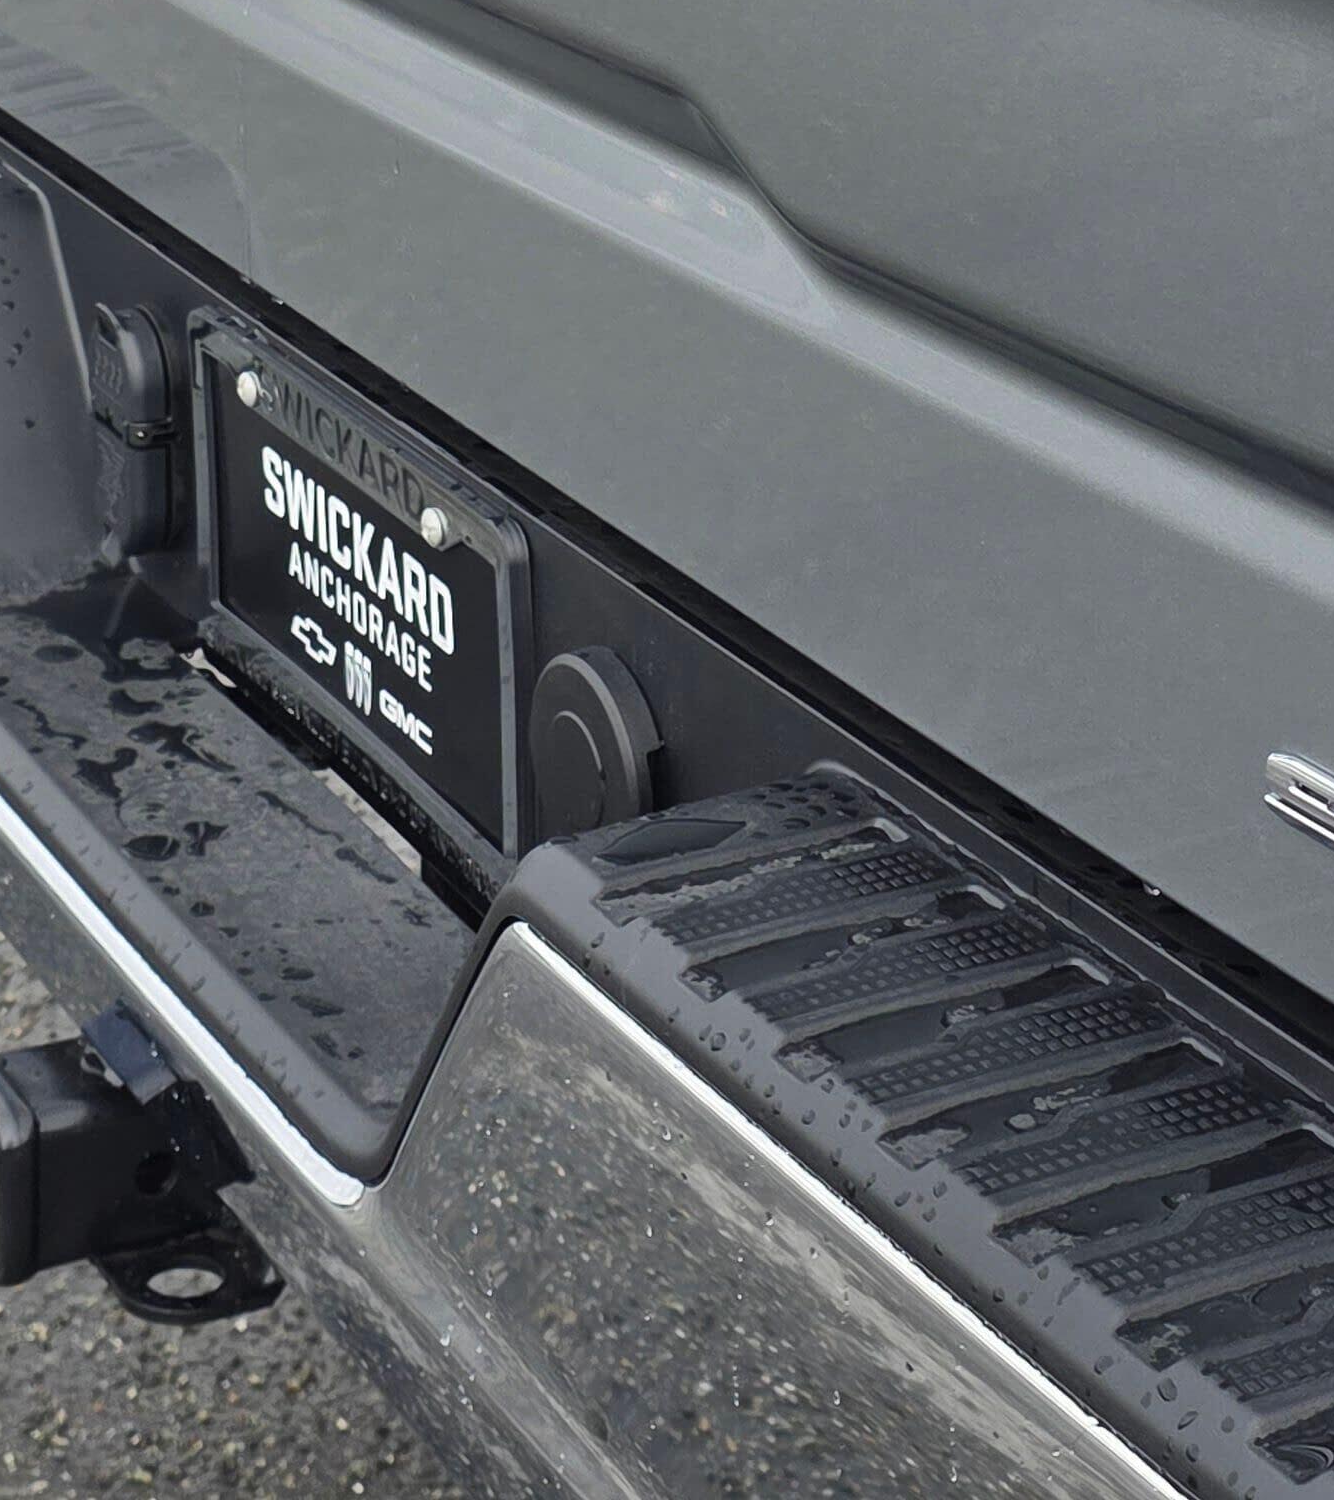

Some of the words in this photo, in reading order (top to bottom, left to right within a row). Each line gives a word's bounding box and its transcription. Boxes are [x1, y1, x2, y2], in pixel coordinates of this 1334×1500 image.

[261, 446, 455, 655] SWICKARD
[288, 541, 433, 693] ANCHORAGE
[378, 688, 434, 756] GMC
